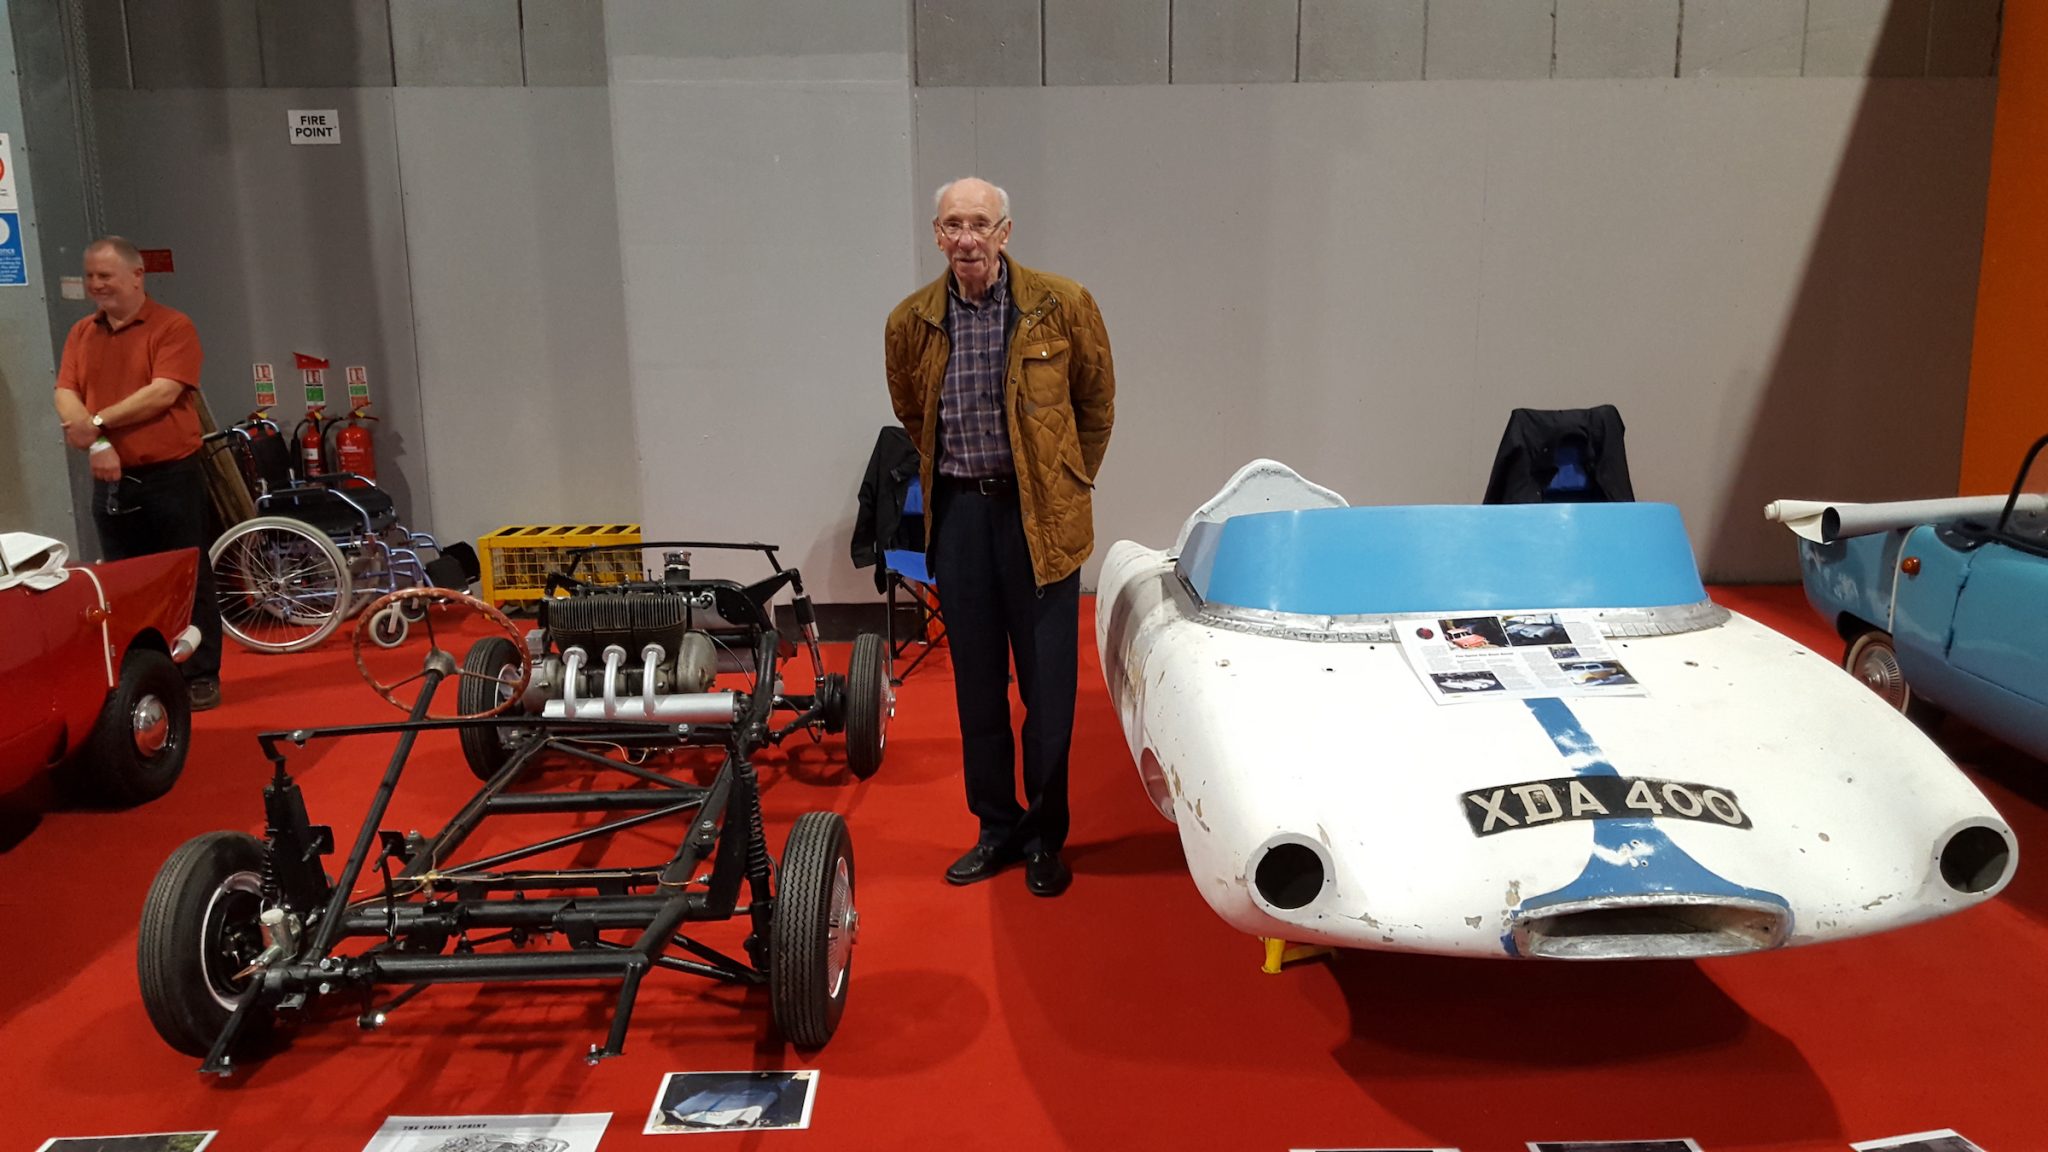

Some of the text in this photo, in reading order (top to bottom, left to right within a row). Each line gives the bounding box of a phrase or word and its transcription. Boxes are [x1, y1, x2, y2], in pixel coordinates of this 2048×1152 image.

[300, 115, 326, 126] FIRE
[295, 127, 333, 138] POINT
[1468, 780, 1743, 832] XDA 400
